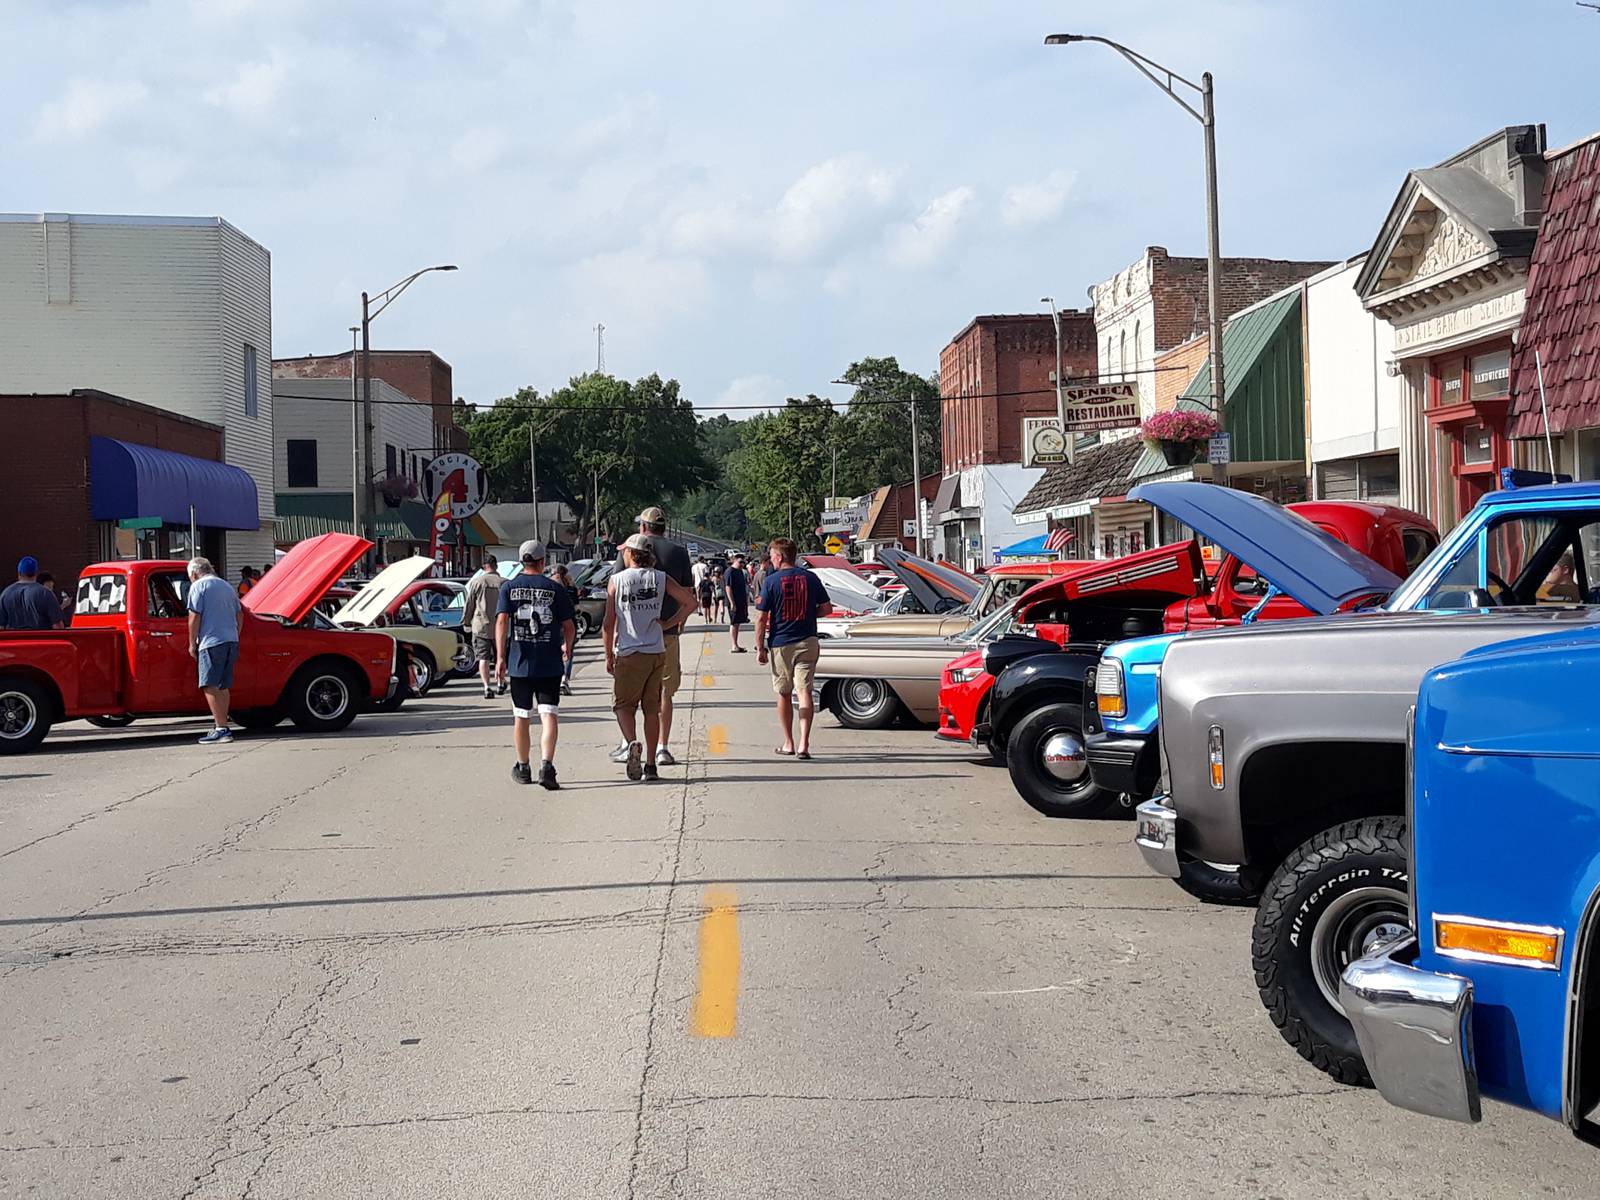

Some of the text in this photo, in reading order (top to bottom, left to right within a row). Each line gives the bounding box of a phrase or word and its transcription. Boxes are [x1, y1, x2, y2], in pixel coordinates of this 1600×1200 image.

[1405, 321, 1433, 343] STATE
[1436, 311, 1457, 335] BANK
[1480, 294, 1518, 320] SENECA
[1067, 385, 1134, 402] SENECA
[1066, 403, 1136, 422] RESTAURANT
[431, 456, 477, 473] SOCIAL
[442, 468, 469, 504] 4
[1289, 868, 1371, 948] All-Terrain
